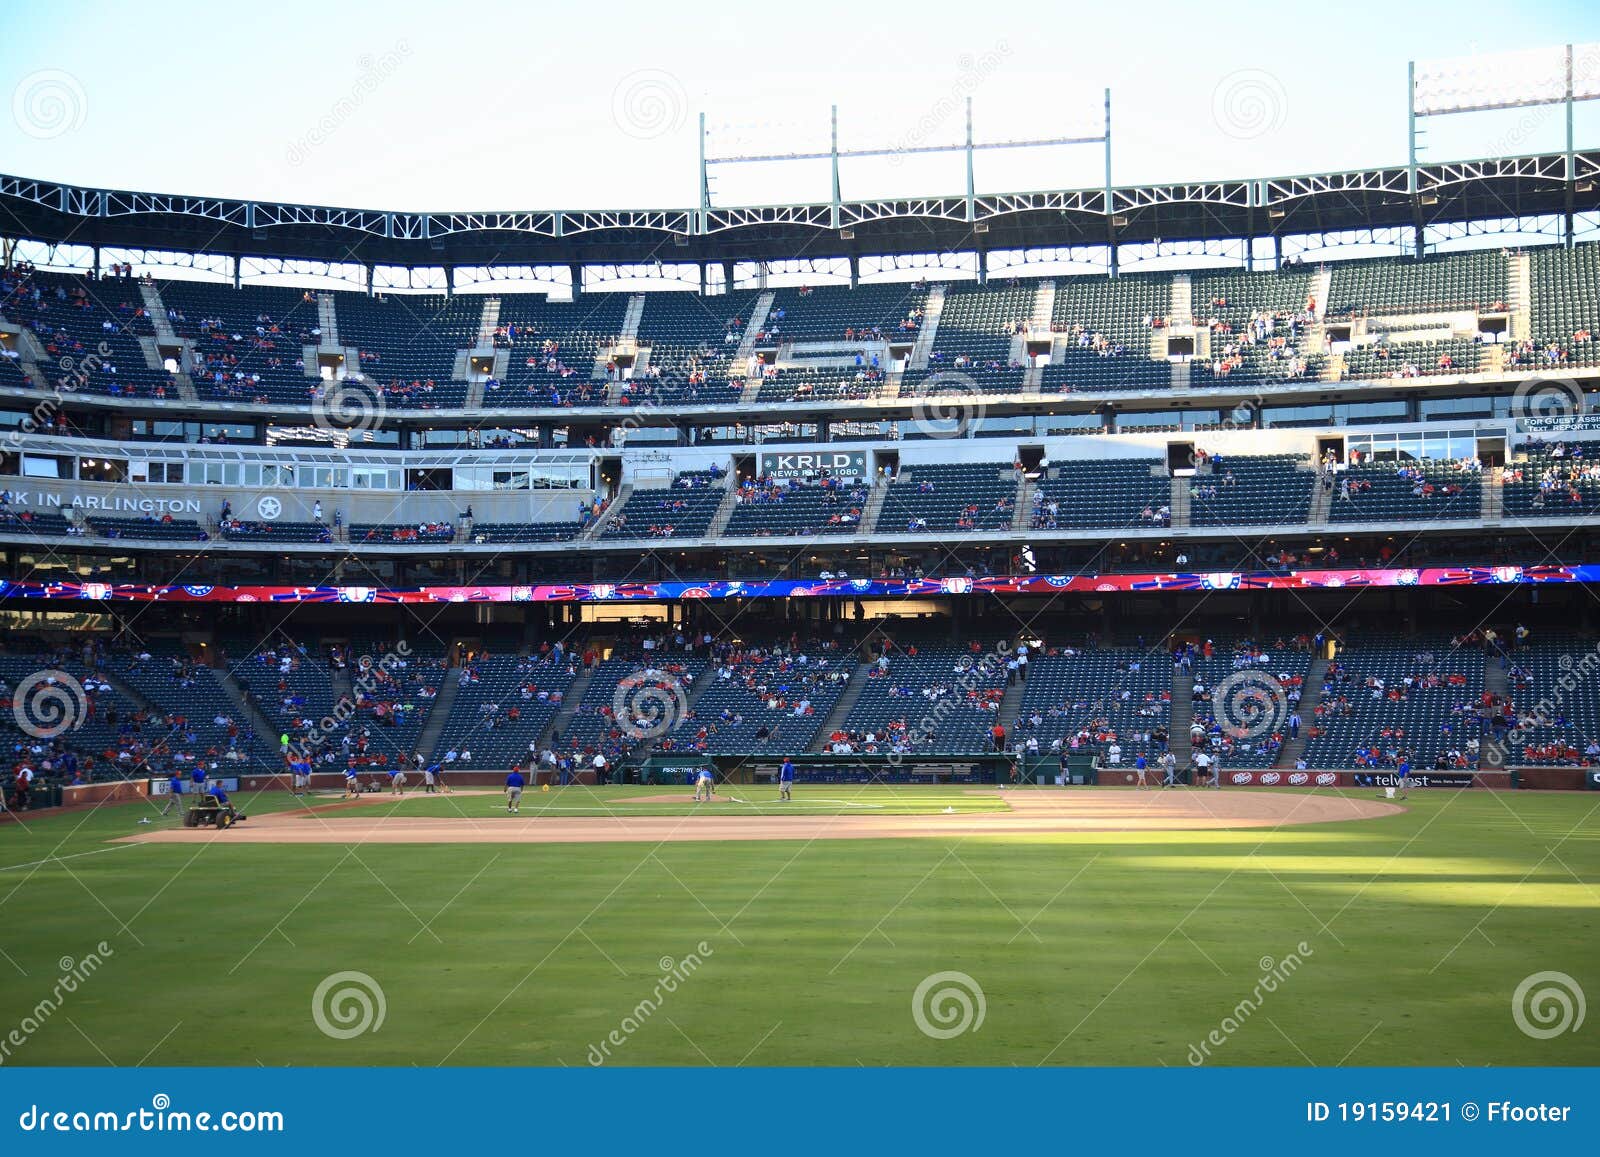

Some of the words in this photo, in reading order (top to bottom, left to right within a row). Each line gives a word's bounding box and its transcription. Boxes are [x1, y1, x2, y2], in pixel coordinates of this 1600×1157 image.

[778, 454, 851, 469] KRLD
[38, 493, 61, 506] IN
[72, 495, 201, 513] ARLINGTON
